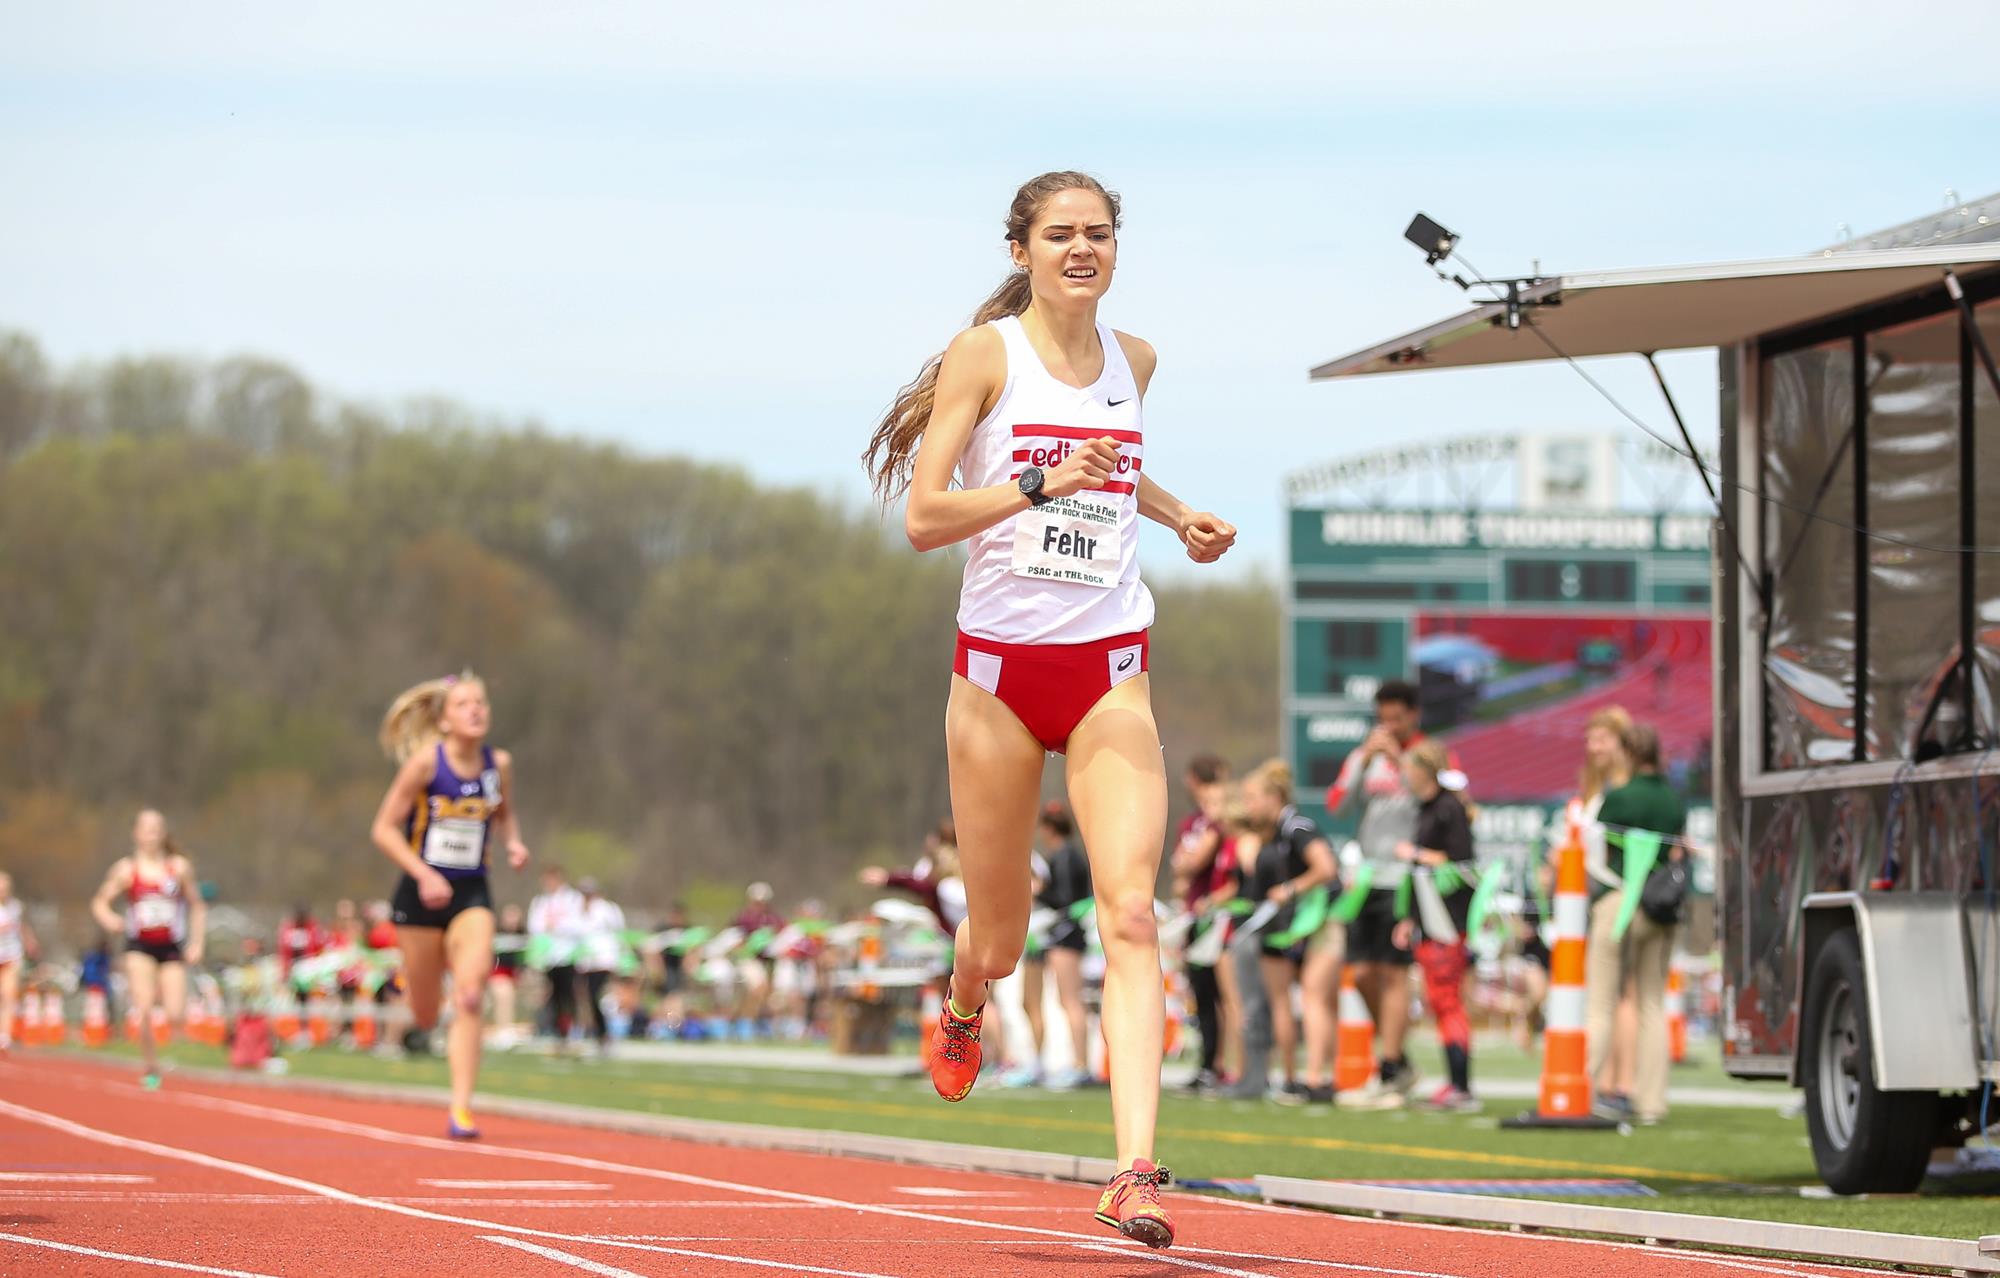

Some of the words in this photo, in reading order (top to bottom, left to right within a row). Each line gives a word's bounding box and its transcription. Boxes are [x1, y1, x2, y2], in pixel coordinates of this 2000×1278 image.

[1062, 508, 1080, 517] ROCK
[1082, 511, 1117, 526] UNIVERSITY
[1072, 500, 1094, 512] Track
[1096, 504, 1101, 513] &
[1101, 506, 1117, 518] Field
[1043, 525, 1097, 560] Fehr
[1027, 566, 1051, 576] PSAC
[1053, 570, 1062, 578] at
[1064, 570, 1083, 580] THE
[1083, 574, 1104, 584] ROCK
